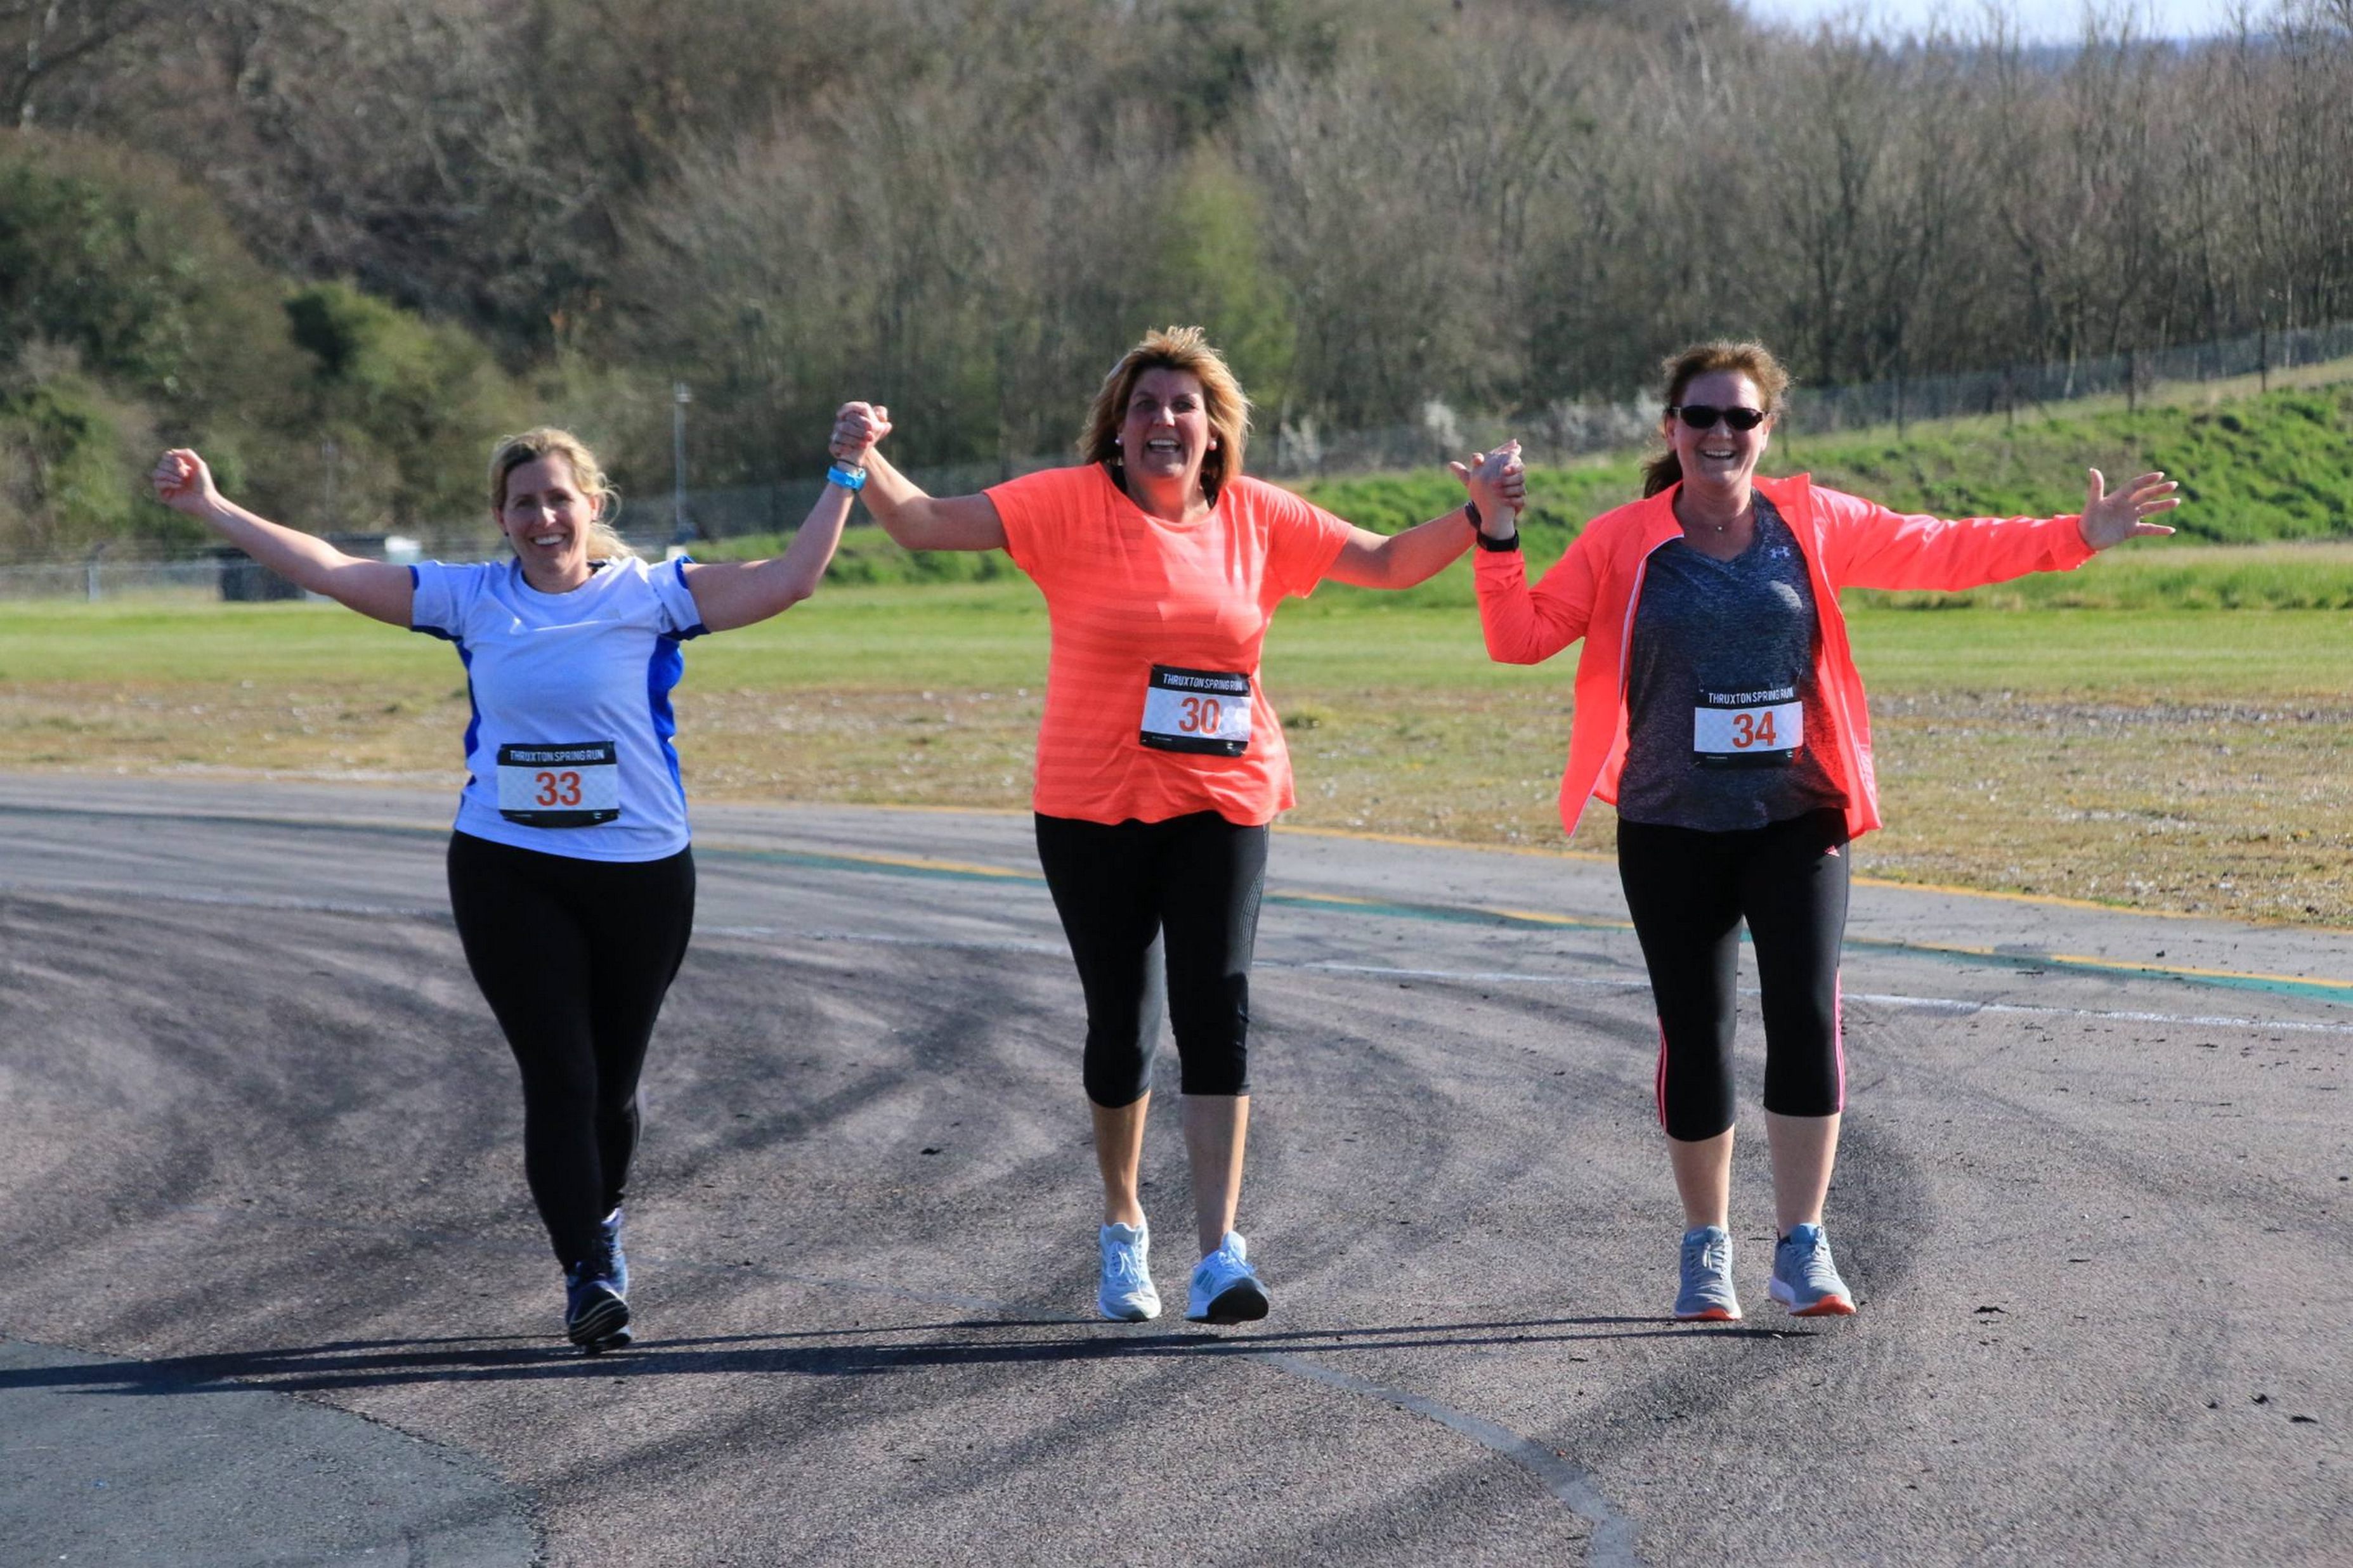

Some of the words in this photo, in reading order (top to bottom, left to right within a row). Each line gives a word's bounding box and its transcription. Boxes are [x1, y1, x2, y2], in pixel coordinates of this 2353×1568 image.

[1163, 673, 1204, 688] THRUXTON
[1205, 678, 1230, 690] SPRING
[1709, 692, 1752, 704] THRUXTON
[1752, 689, 1780, 703] SPRING
[1178, 697, 1220, 735] 30
[1733, 711, 1776, 748] 34
[510, 750, 553, 761] THRUXTON
[554, 750, 585, 761] SPRING
[586, 749, 605, 761] RUN
[535, 771, 582, 807] 33
